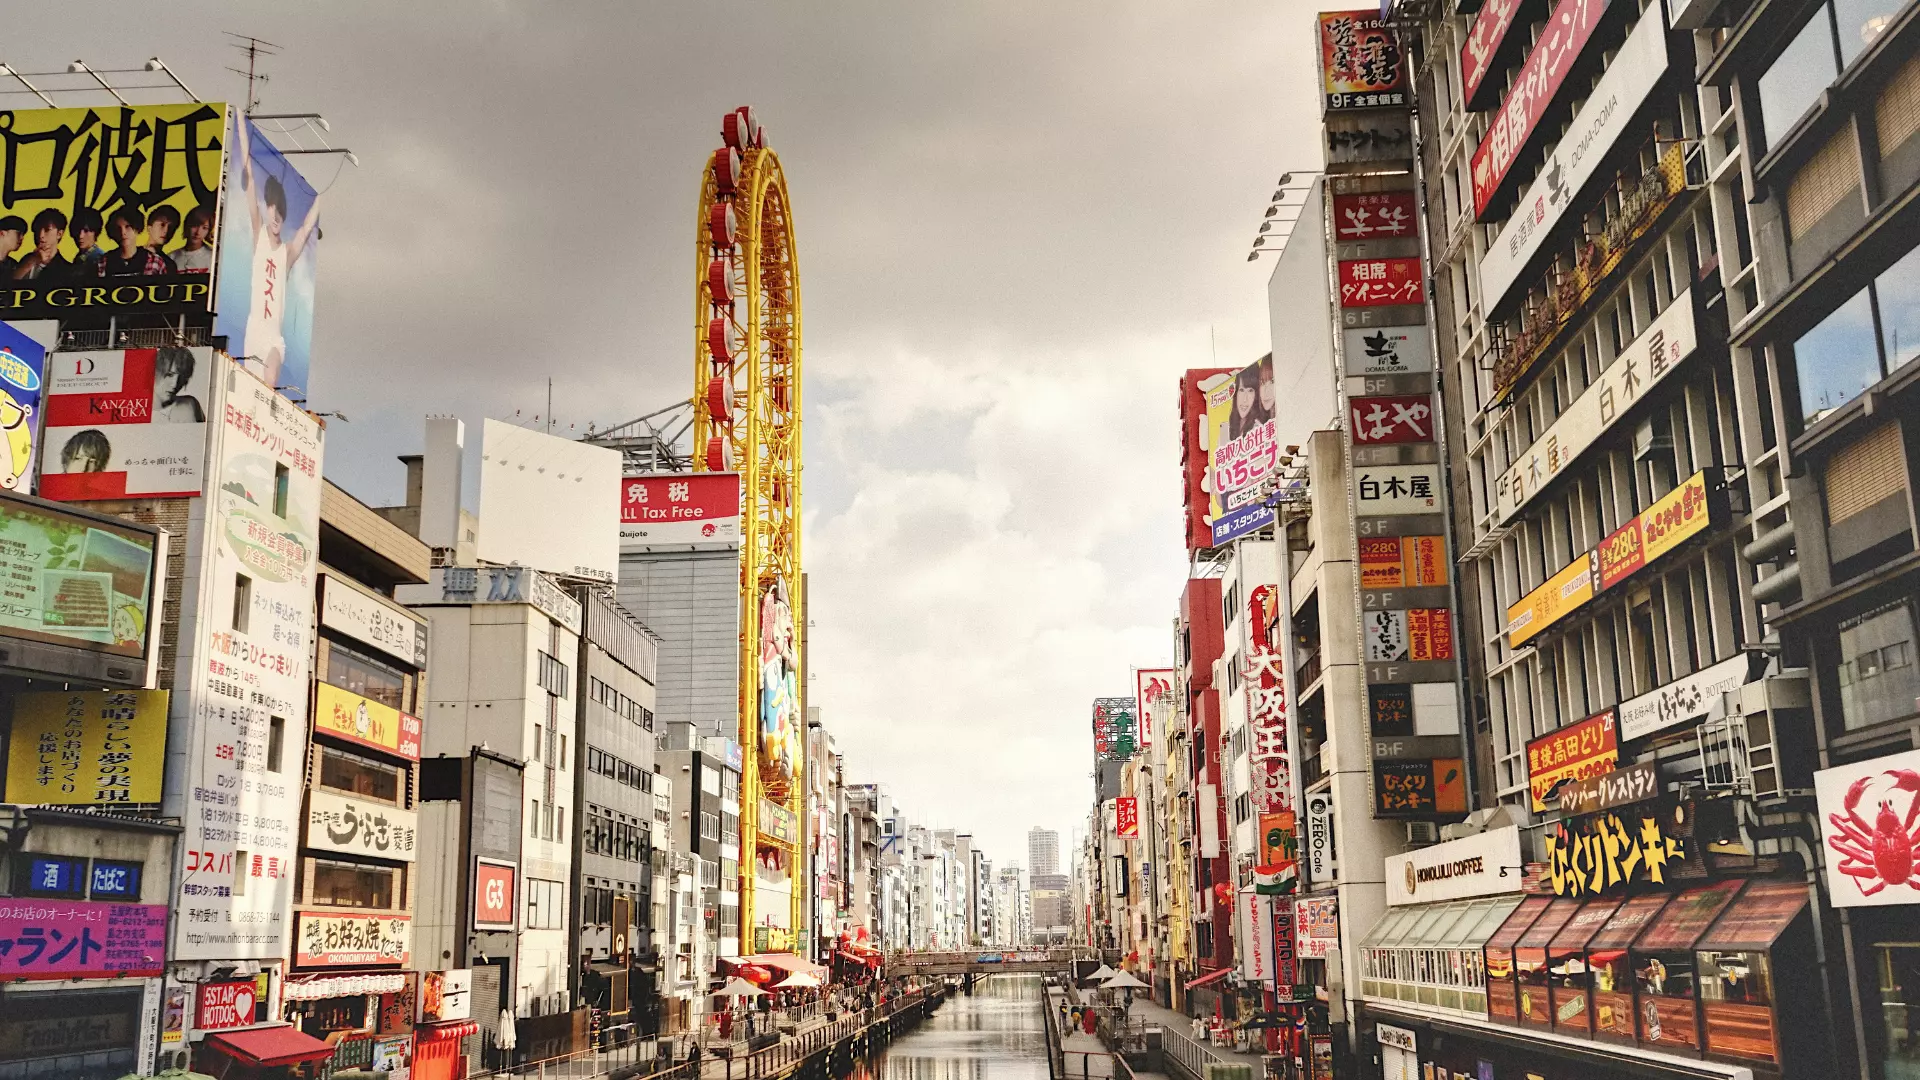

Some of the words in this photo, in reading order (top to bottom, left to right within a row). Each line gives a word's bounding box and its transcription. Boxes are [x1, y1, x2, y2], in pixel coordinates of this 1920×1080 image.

[1332, 93, 1351, 108] 9F
[1354, 92, 1403, 107] 全室個室
[1489, 83, 1527, 178] 相席
[1525, 0, 1588, 121] ダイニン
[1570, 93, 1618, 169] DOMA-DOMA
[1352, 263, 1387, 281] 相席
[45, 284, 208, 306] GROUP
[264, 257, 277, 319] ホスト
[1342, 279, 1421, 303] ダイニング
[1345, 310, 1372, 325] 6F
[1365, 378, 1387, 393] 5F
[1599, 328, 1670, 428] 白木屋
[89, 397, 149, 414] KANZAKI
[110, 406, 148, 422] RUKA
[225, 403, 317, 479] 日本原カンツリー倶楽部
[1215, 421, 1276, 468] 高収入お仕事
[124, 455, 189, 467] めっちゃ面白いを
[1355, 448, 1384, 462] 4F
[1498, 476, 1509, 500] 4F
[1511, 434, 1562, 508] 白木屋
[1360, 475, 1434, 501] 白木屋
[642, 506, 668, 519] Tax
[672, 505, 704, 518] Free
[1360, 521, 1388, 535] 3F
[1366, 593, 1392, 607] 2F
[1372, 666, 1399, 681] 1F
[1239, 644, 1290, 811] 大阪王将
[1602, 712, 1614, 731] 2F
[60, 695, 86, 794] あなたのお店づくり
[93, 693, 137, 802] 素晴らしい夢の実現
[1375, 742, 1403, 757] B1F
[1529, 722, 1604, 771] 豊後高田どり
[36, 731, 59, 786] 応援します
[1383, 773, 1426, 792] びっくり
[1561, 768, 1656, 811] ハンバーグレストラン
[1126, 799, 1136, 823] ツルハ
[1381, 791, 1431, 810] ドンキー
[1311, 816, 1325, 850] ZERO
[186, 850, 234, 875] コスパ
[1544, 812, 1685, 898] びっくりドンキー
[43, 863, 59, 888] 酒
[92, 865, 125, 891] たばこ
[1416, 860, 1453, 884] HONOLULU
[1453, 855, 1484, 878] COFFEE
[485, 878, 505, 910] G3
[324, 917, 381, 951] お好み焼
[328, 953, 377, 964] OKONOMIYAKI
[205, 984, 234, 1006] 5STAR
[203, 1003, 236, 1025] HOTDOG
